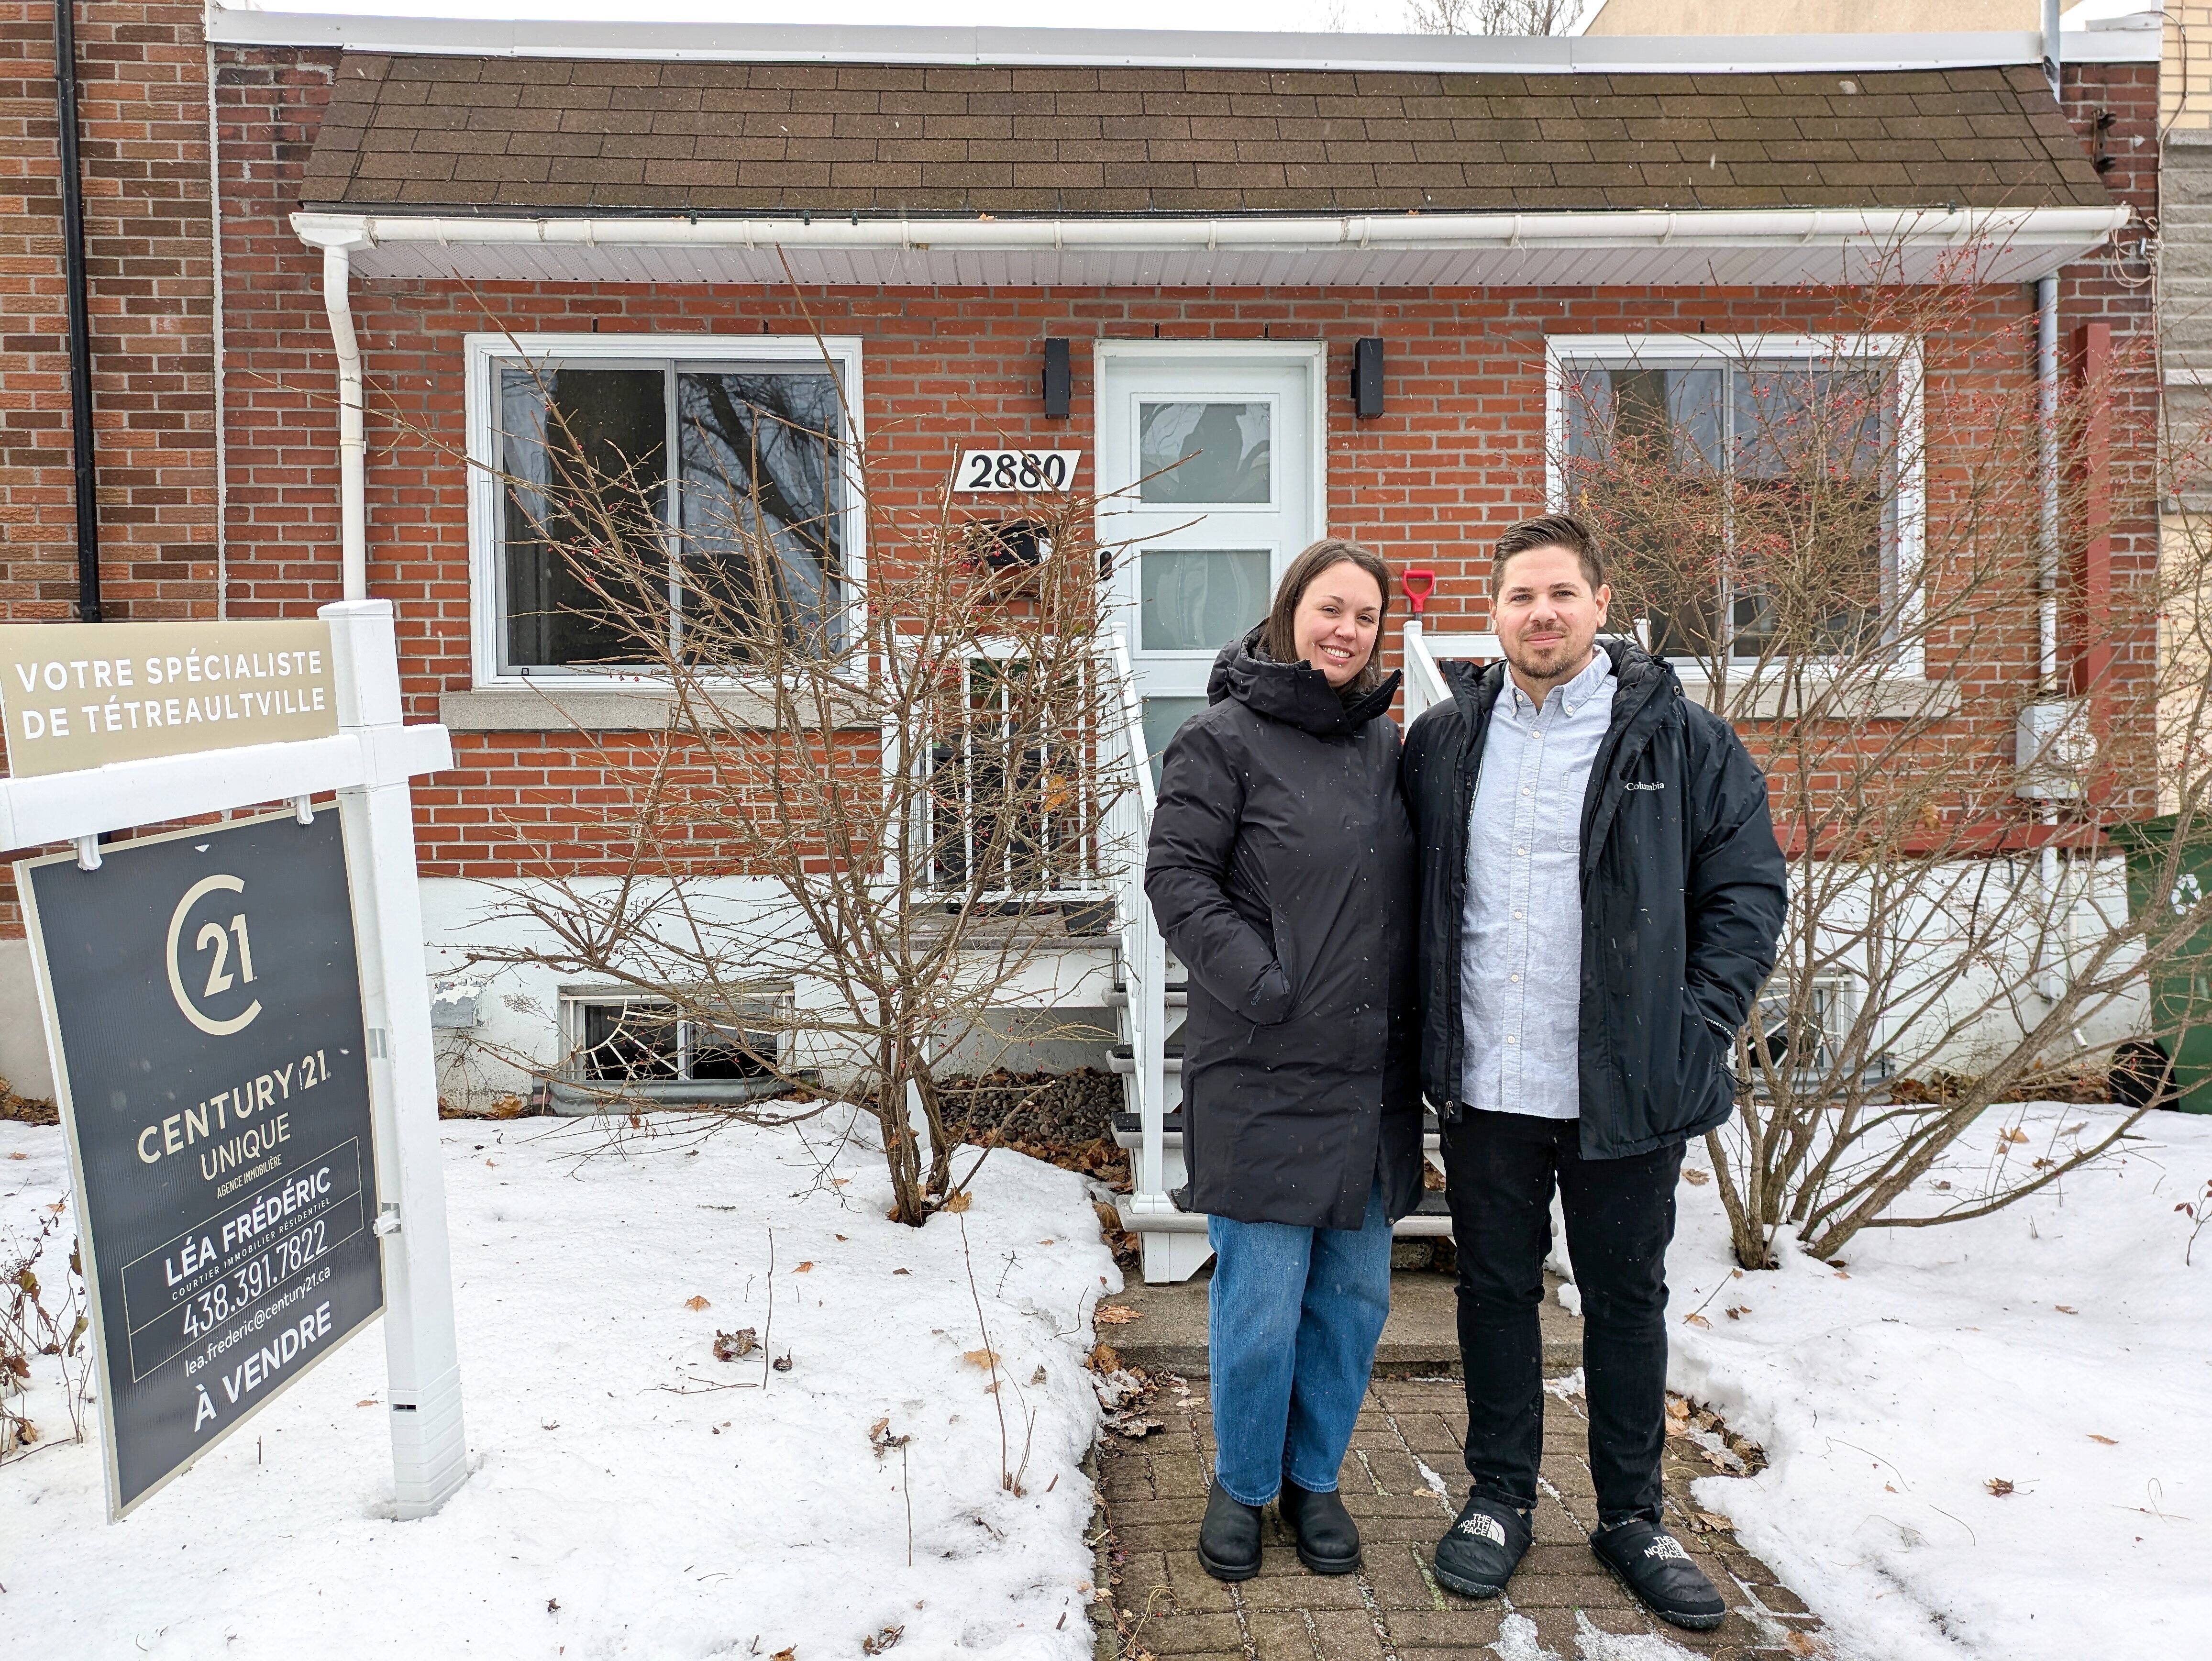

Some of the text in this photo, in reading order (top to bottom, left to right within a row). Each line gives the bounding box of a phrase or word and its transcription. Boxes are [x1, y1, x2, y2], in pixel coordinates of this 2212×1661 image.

[969, 454, 1065, 488] 2880
[16, 648, 322, 692] VOTRE SPÉCIALISTE
[22, 687, 325, 739] DE TÉTREAULTVILLE
[1626, 781, 1664, 791] Columbia
[1703, 1016, 1736, 1041] OMNI-TEC
[137, 1063, 293, 1164] CENTURY
[201, 1112, 291, 1181] UNIQUE
[217, 1154, 282, 1199] AGENCE IMMOBILIÈRE
[165, 1167, 331, 1286] LÉA FRÉDÉRIC
[172, 1198, 330, 1300] COURTIER IMMOBILIER RÉSIDENTIEL
[184, 1219, 328, 1339] 438.391.7822
[186, 1265, 331, 1378] lea.frederic@century21.ca
[194, 1301, 332, 1432] À VENDRE
[1463, 1527, 1488, 1537] FACE
[1473, 1513, 1492, 1523] THE
[1653, 1536, 1673, 1544] THE
[1644, 1541, 1678, 1558] NORTH
[1658, 1550, 1682, 1560] FACE
